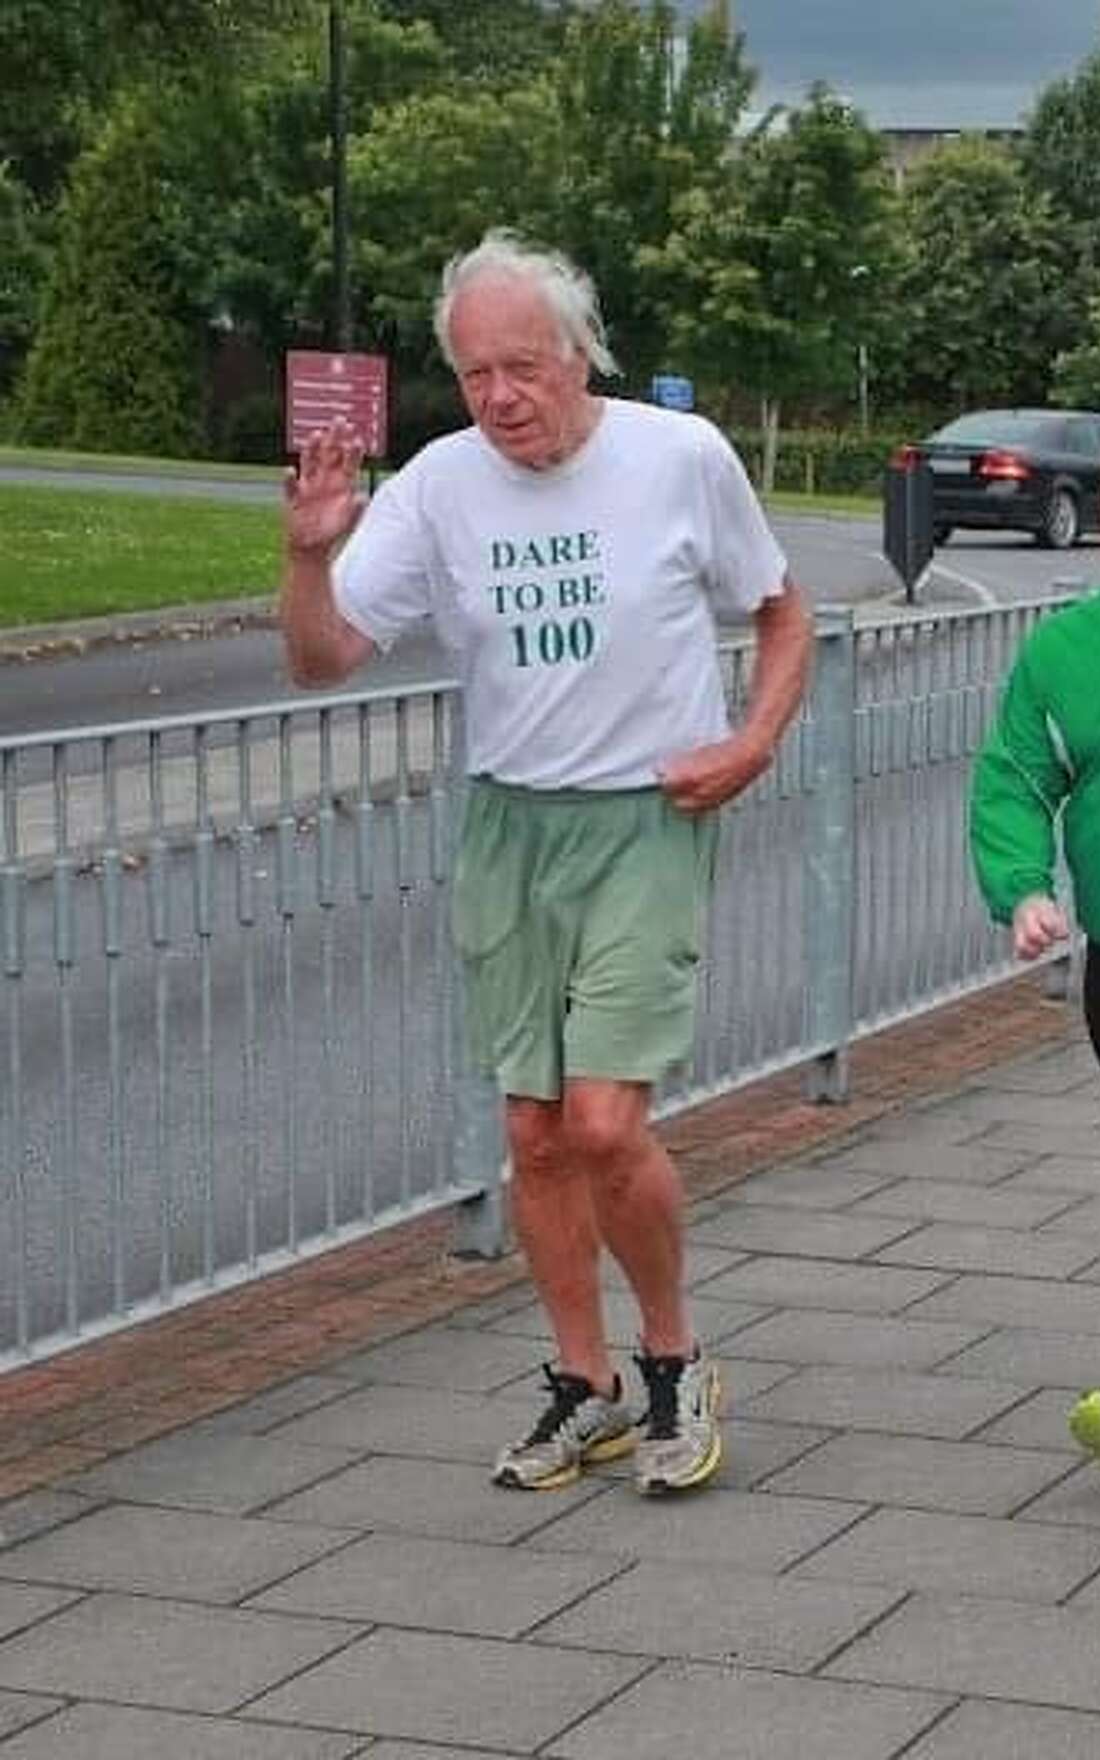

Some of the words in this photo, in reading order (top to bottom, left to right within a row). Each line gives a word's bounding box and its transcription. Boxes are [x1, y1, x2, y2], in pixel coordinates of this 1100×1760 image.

[492, 530, 600, 570] DARE
[488, 583, 544, 614] TO
[558, 573, 606, 608] BE
[512, 617, 594, 667] 100
